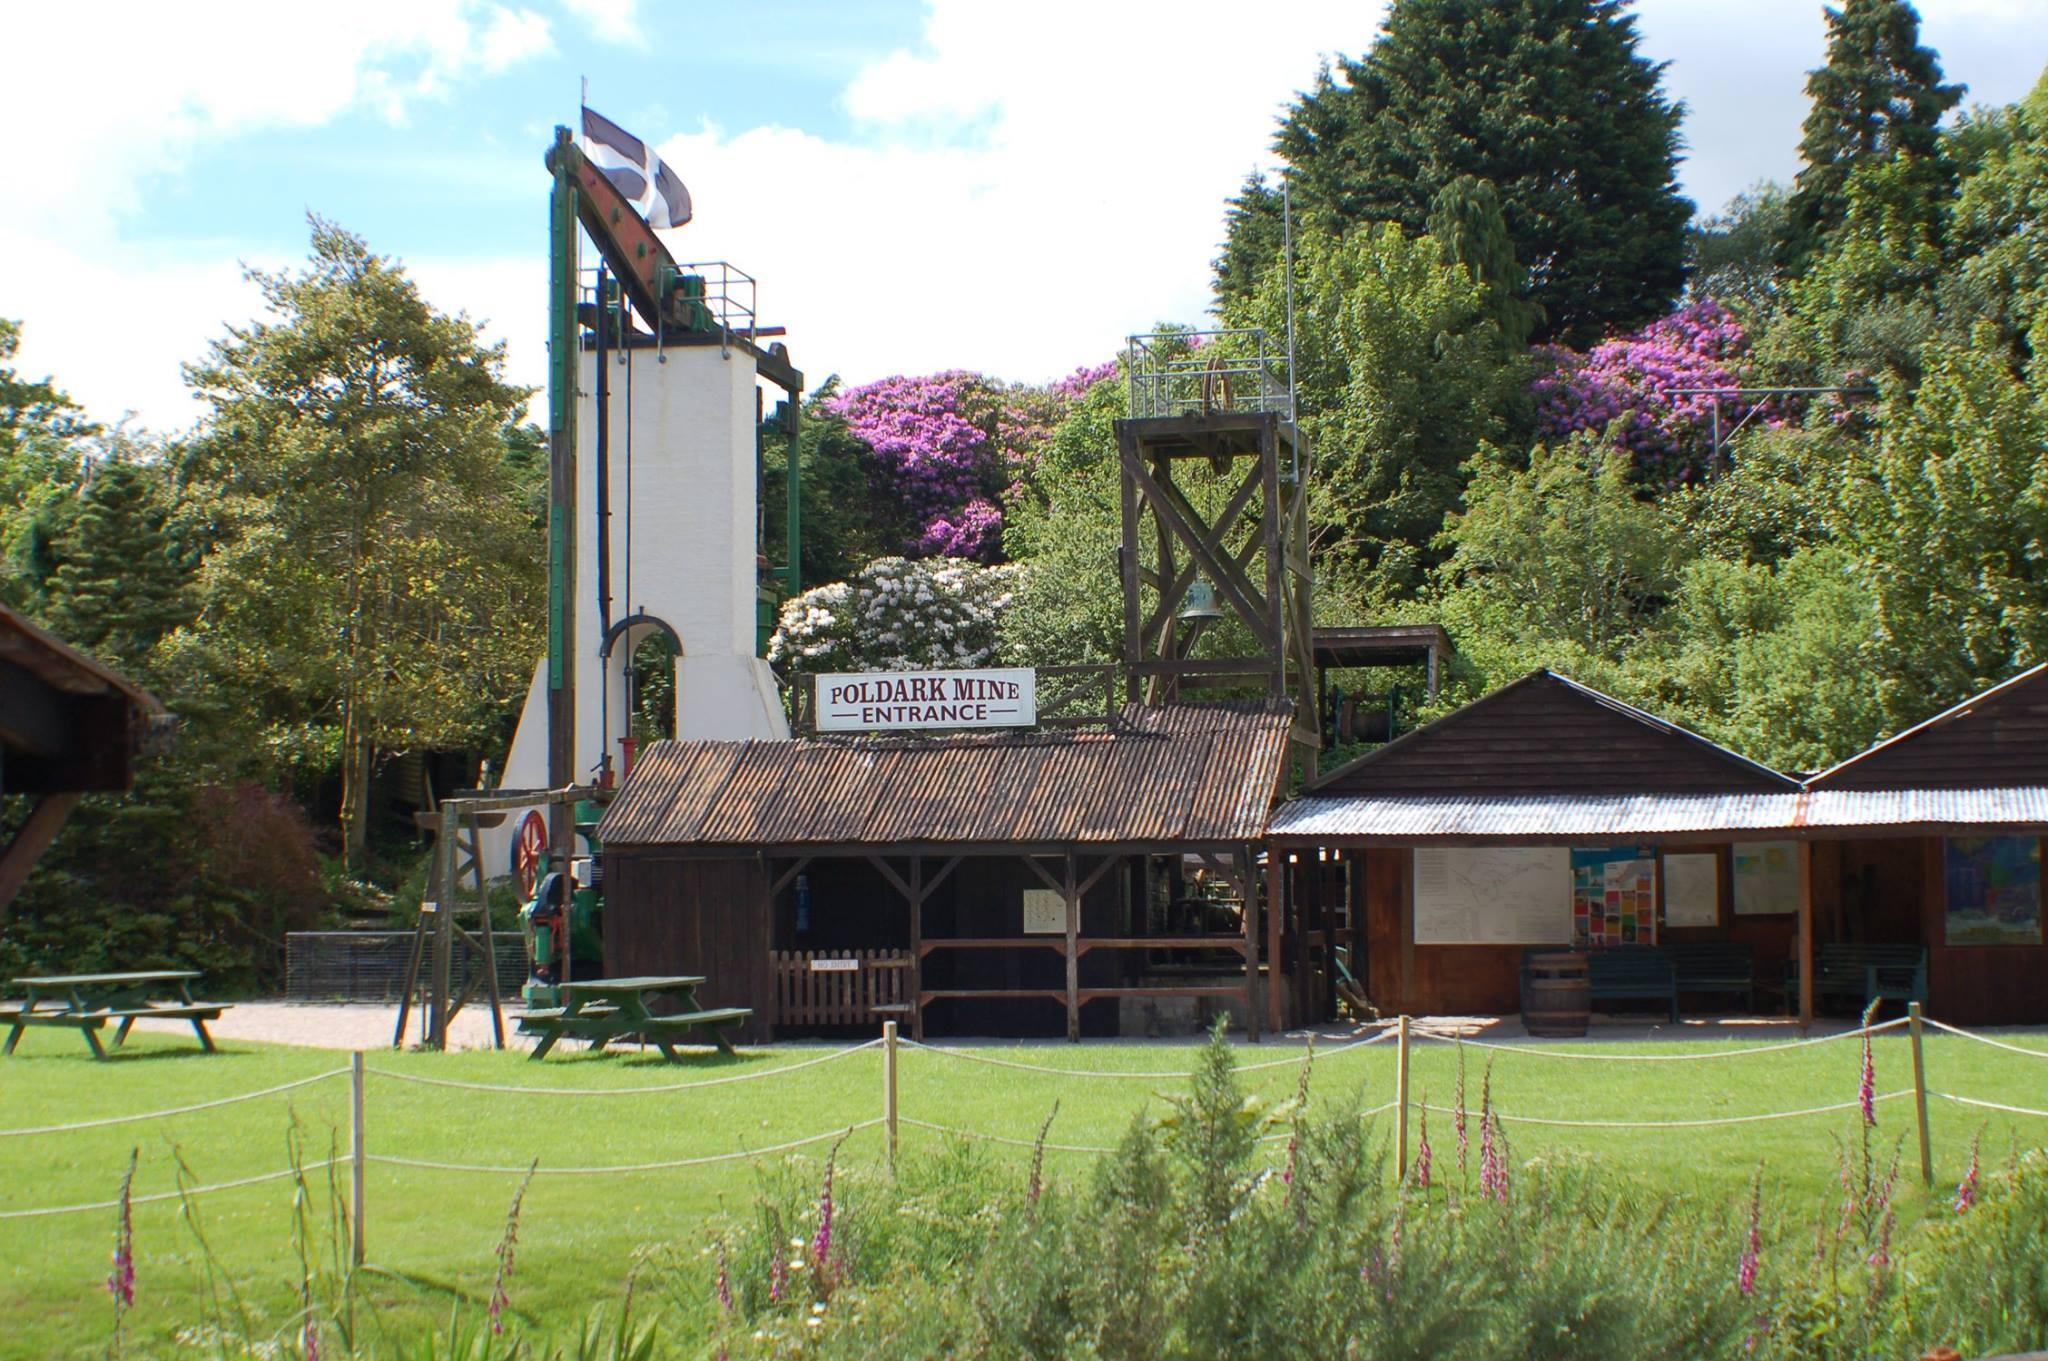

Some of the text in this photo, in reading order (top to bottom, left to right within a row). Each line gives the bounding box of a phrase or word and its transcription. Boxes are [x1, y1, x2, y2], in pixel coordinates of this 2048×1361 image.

[831, 677, 1020, 705] POLDARK MINE
[862, 704, 988, 724] ENTRANCE
